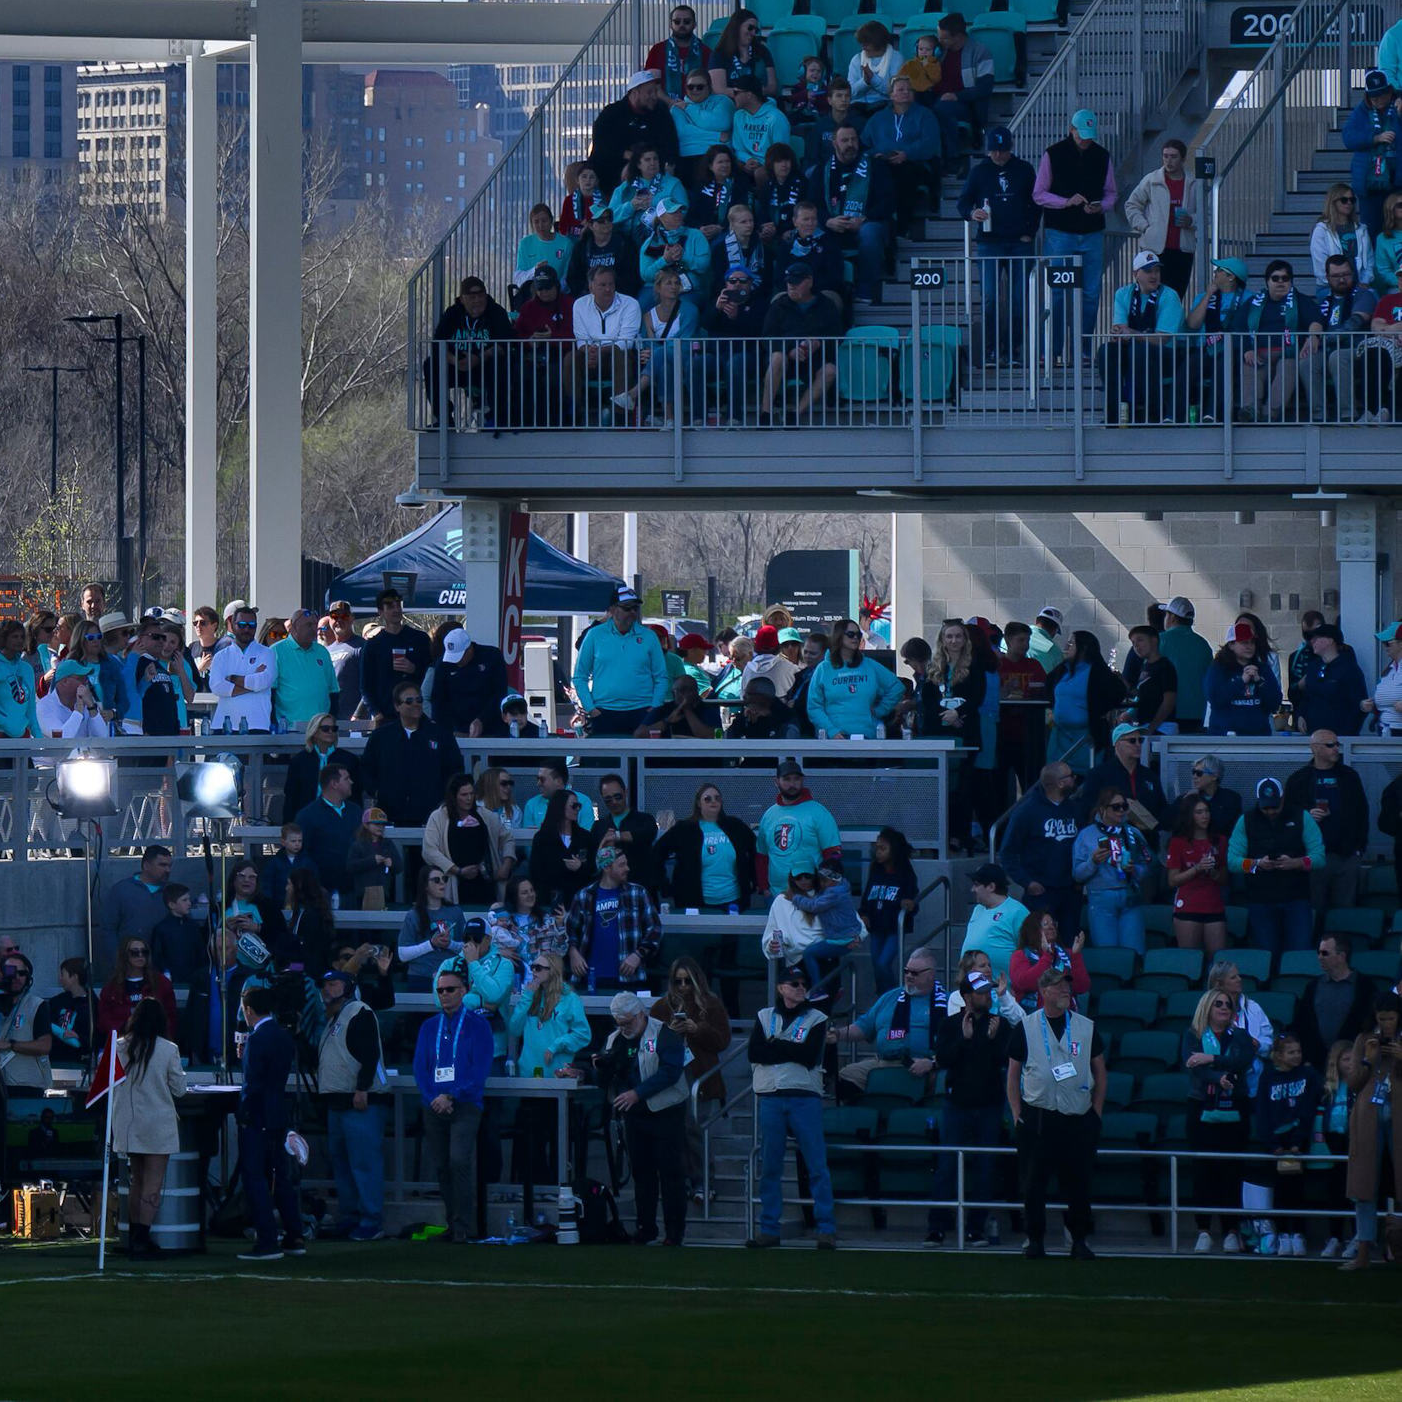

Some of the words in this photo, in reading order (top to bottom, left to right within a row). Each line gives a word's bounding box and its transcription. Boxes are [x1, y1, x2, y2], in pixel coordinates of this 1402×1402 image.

[1243, 14, 1294, 37] 200
[914, 274, 941, 286] 200
[1053, 272, 1075, 284] 201
[503, 537, 526, 666] KC
[807, 615, 820, 623] Entry
[1043, 817, 1079, 842] Blvd
